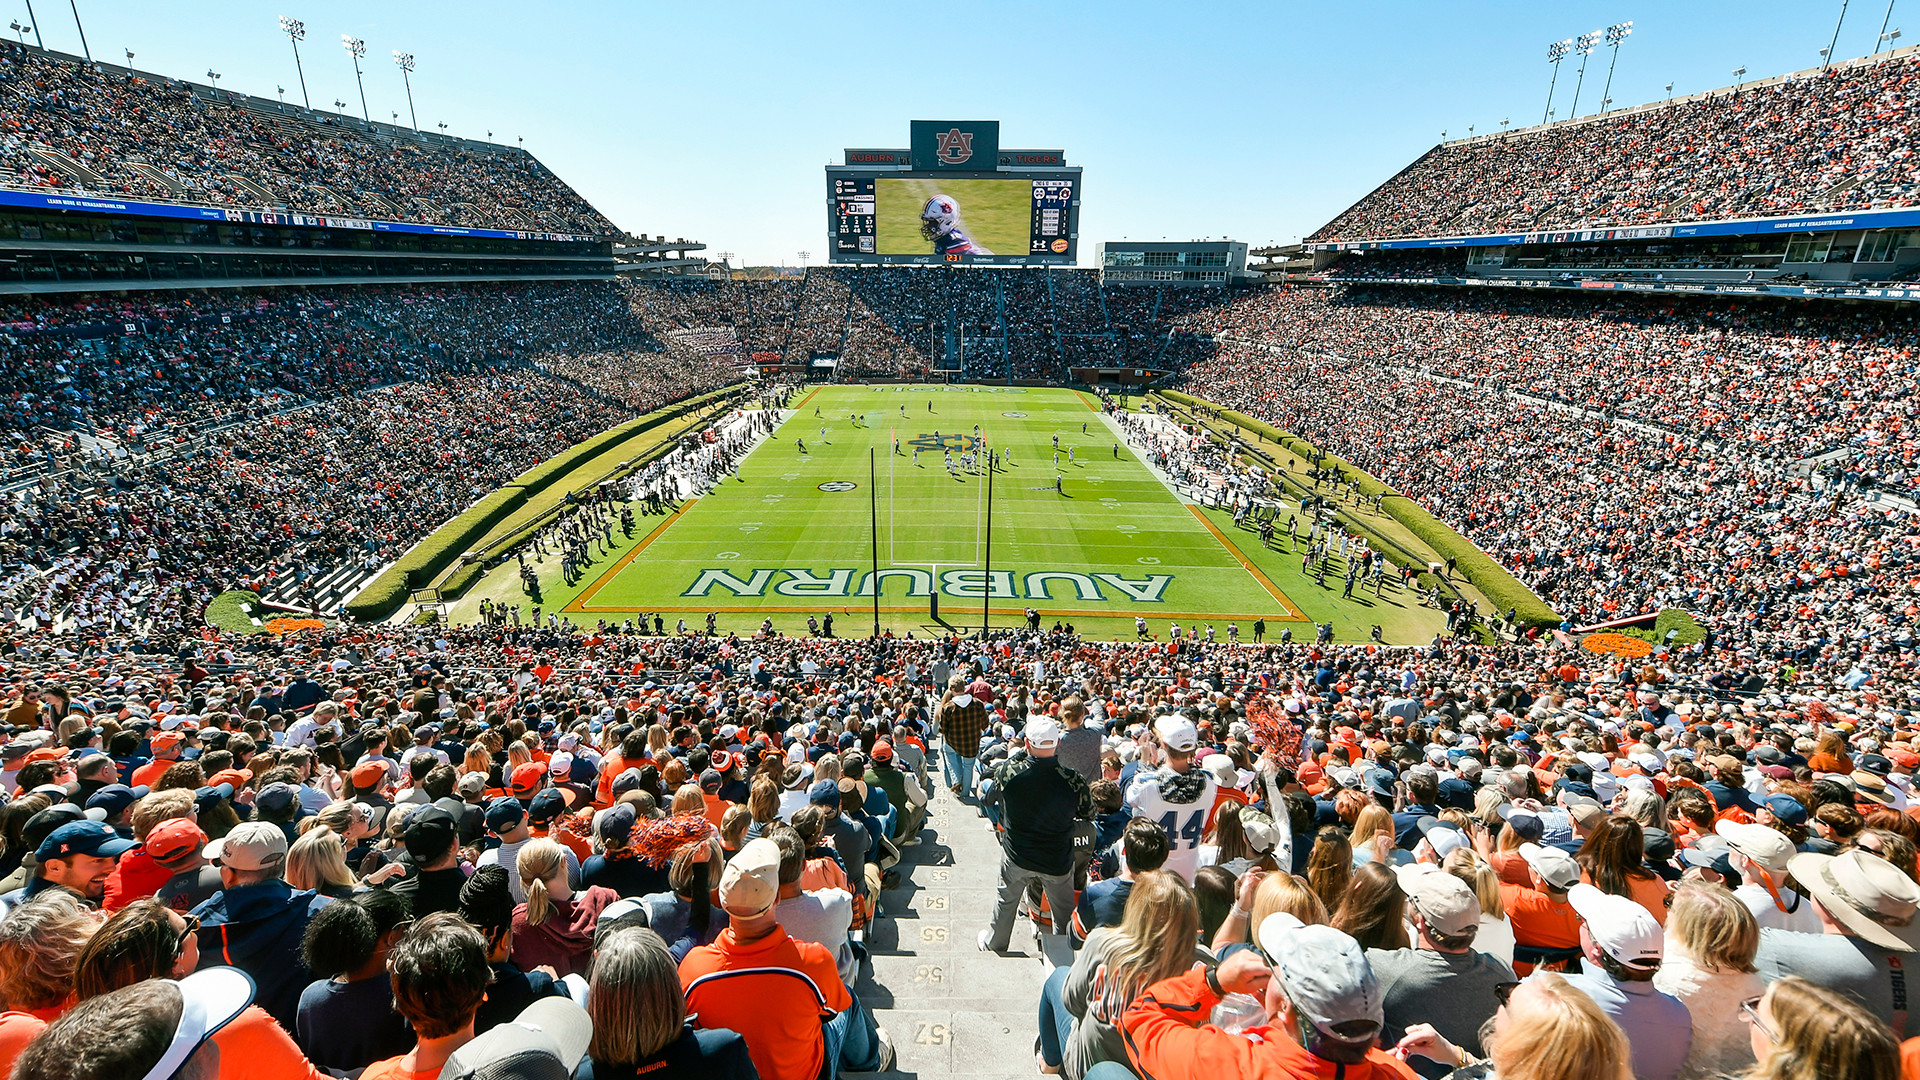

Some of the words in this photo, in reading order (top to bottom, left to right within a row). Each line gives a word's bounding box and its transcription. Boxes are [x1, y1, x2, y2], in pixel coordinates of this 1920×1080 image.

[936, 128, 973, 164] AU
[851, 154, 894, 162] AUBURN
[1017, 155, 1058, 163] TIGERS
[680, 568, 1176, 603] AUBURN
[1158, 808, 1206, 851] 44
[931, 870, 949, 882] 53
[926, 897, 945, 909] 54
[923, 928, 946, 942] 55
[1889, 969, 1908, 1011] TIGERS
[914, 1023, 946, 1046] 57
[636, 1060, 668, 1075] AUBURN
